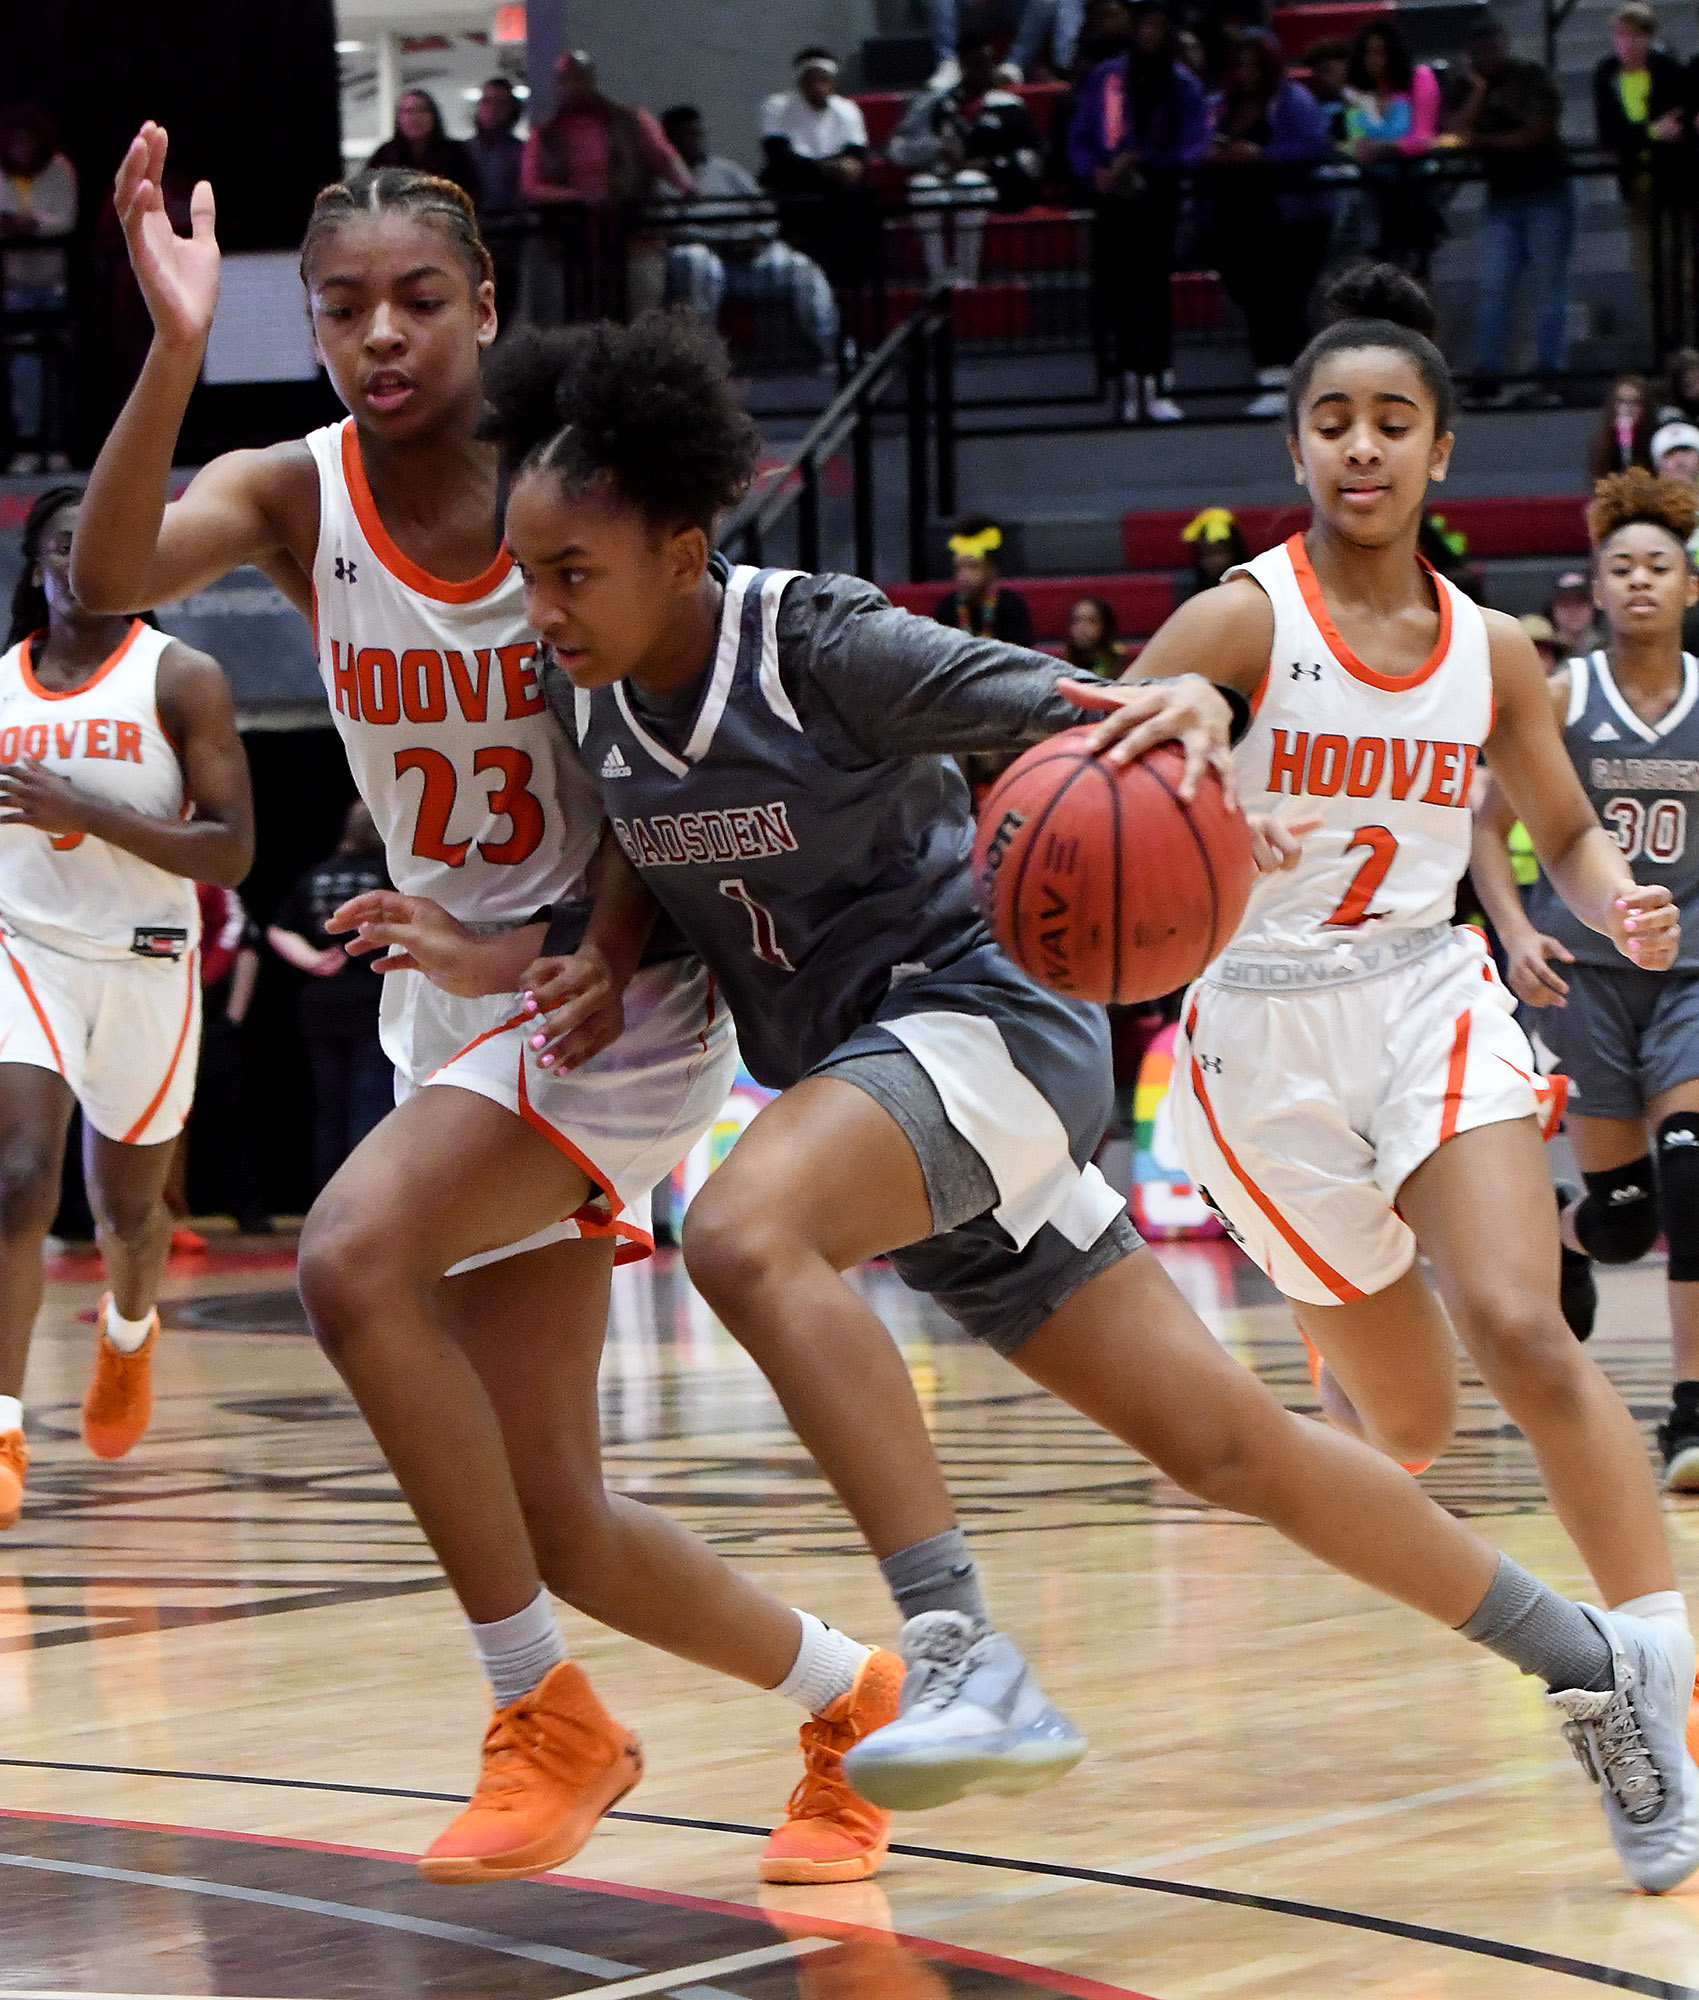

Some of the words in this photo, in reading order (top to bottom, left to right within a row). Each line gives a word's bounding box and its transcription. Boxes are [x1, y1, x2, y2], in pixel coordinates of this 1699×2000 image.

[394, 746, 545, 868] 23
[613, 801, 799, 867] GADSDEN
[1604, 797, 1687, 864] 30
[1321, 825, 1392, 926] 2
[719, 878, 796, 972] 1
